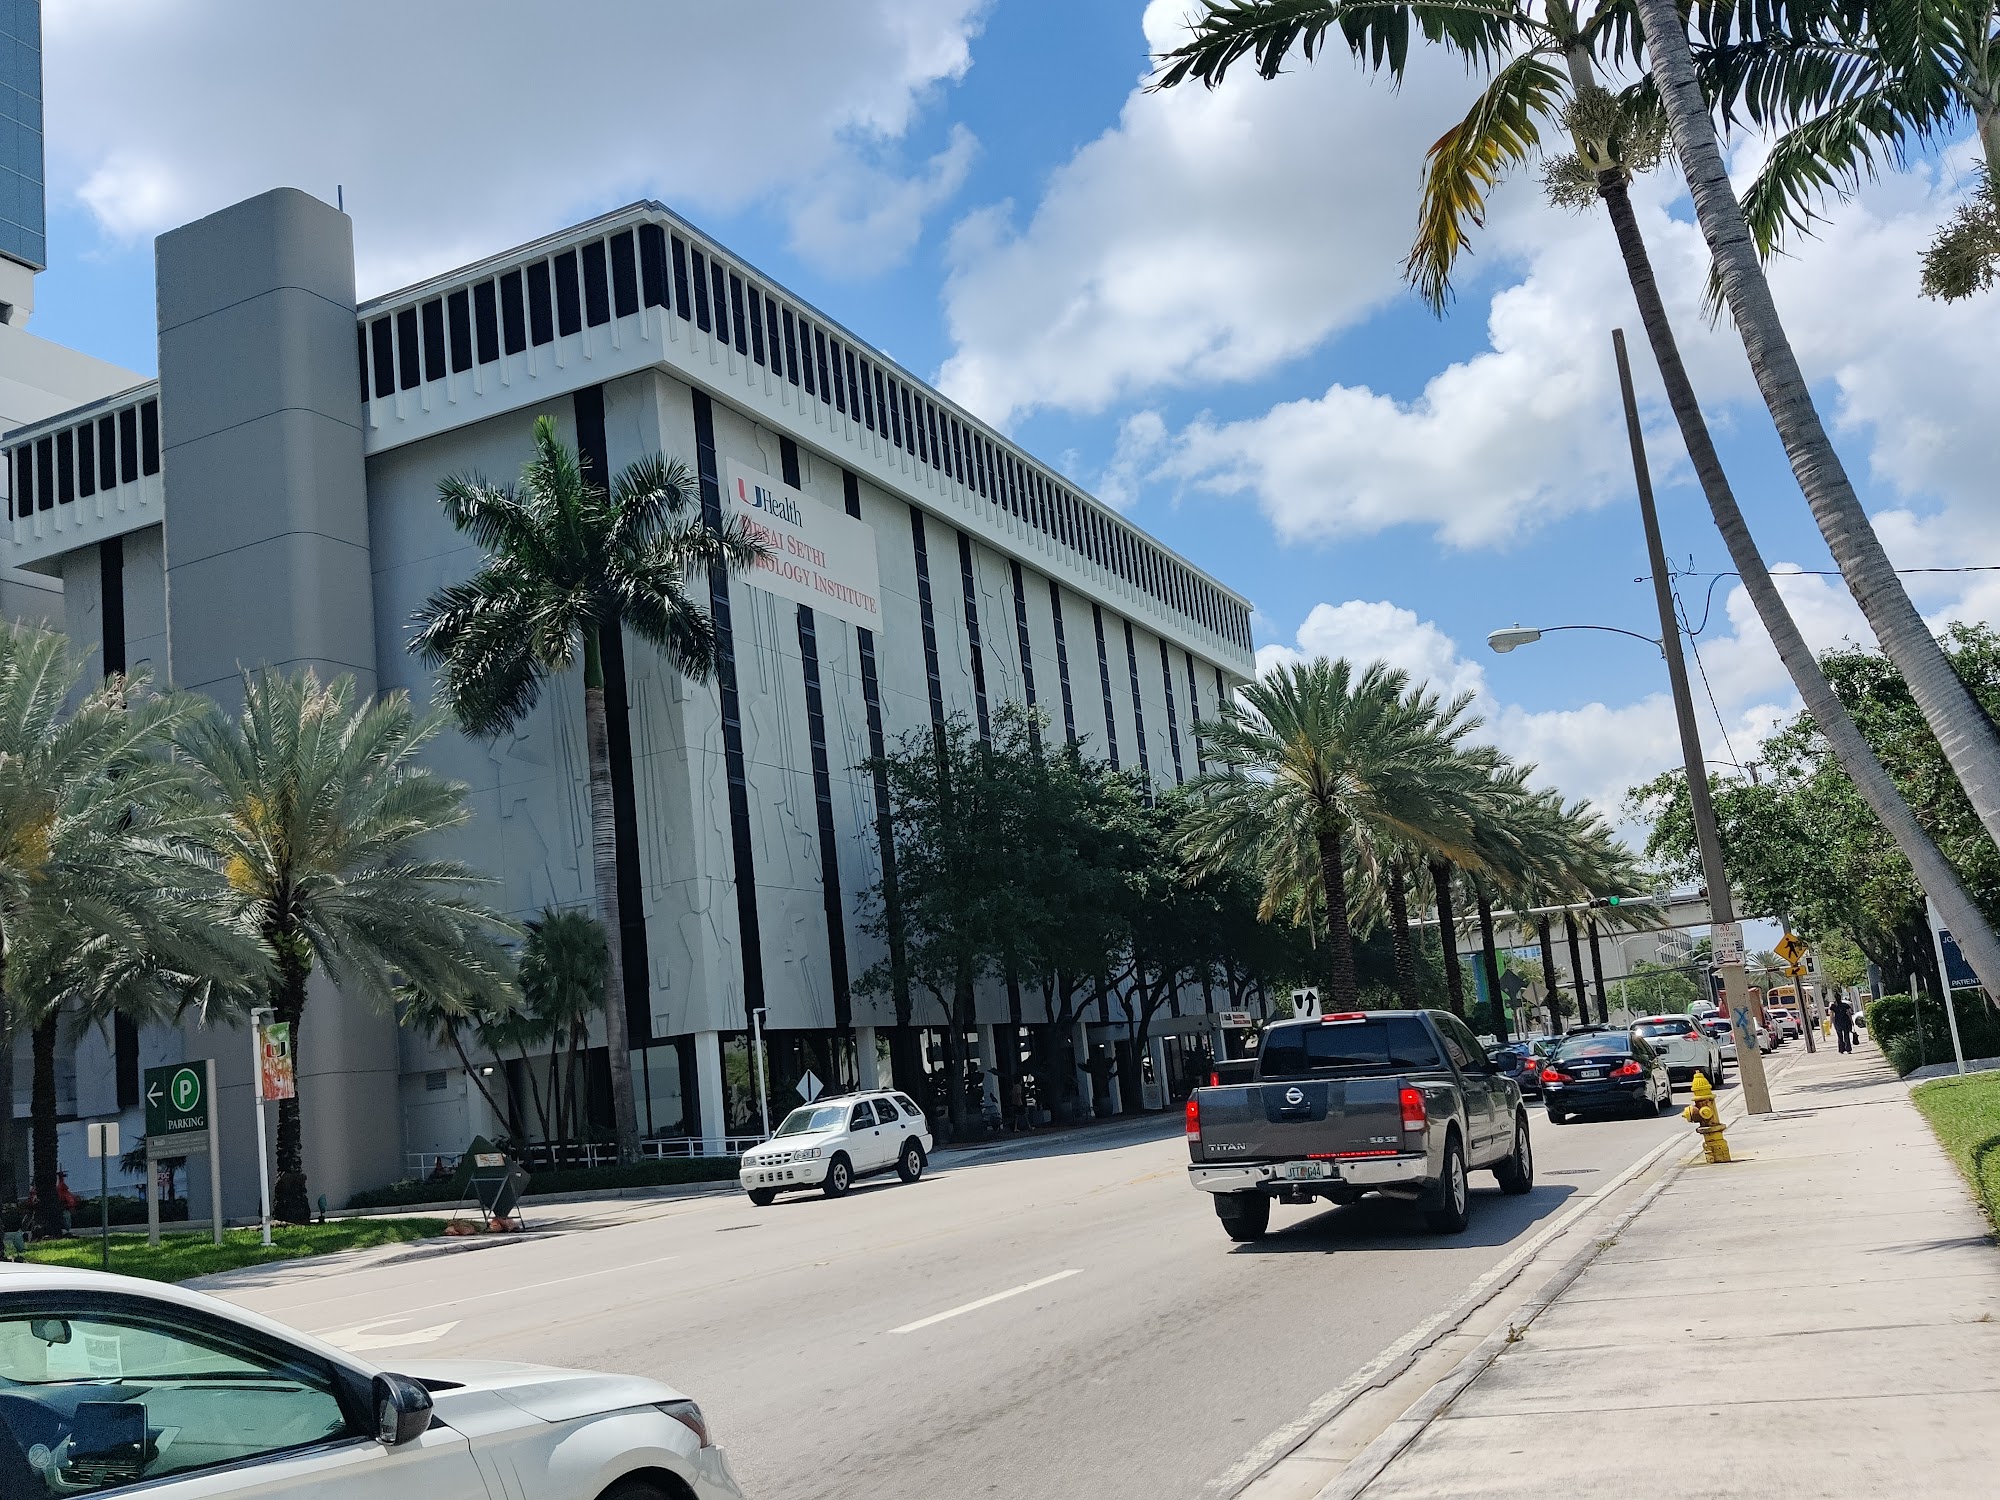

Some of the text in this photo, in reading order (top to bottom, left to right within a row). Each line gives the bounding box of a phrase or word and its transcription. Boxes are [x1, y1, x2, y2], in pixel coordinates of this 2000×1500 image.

[787, 535, 827, 569] SETHI
[754, 553, 877, 614] ROLOGY INSTITUTE
[1942, 936, 1955, 944] JO
[1951, 978, 1980, 987] PATIENT
[179, 1079, 192, 1104] P
[168, 1116, 204, 1130] PARKING
[1208, 1142, 1246, 1151] TITAN
